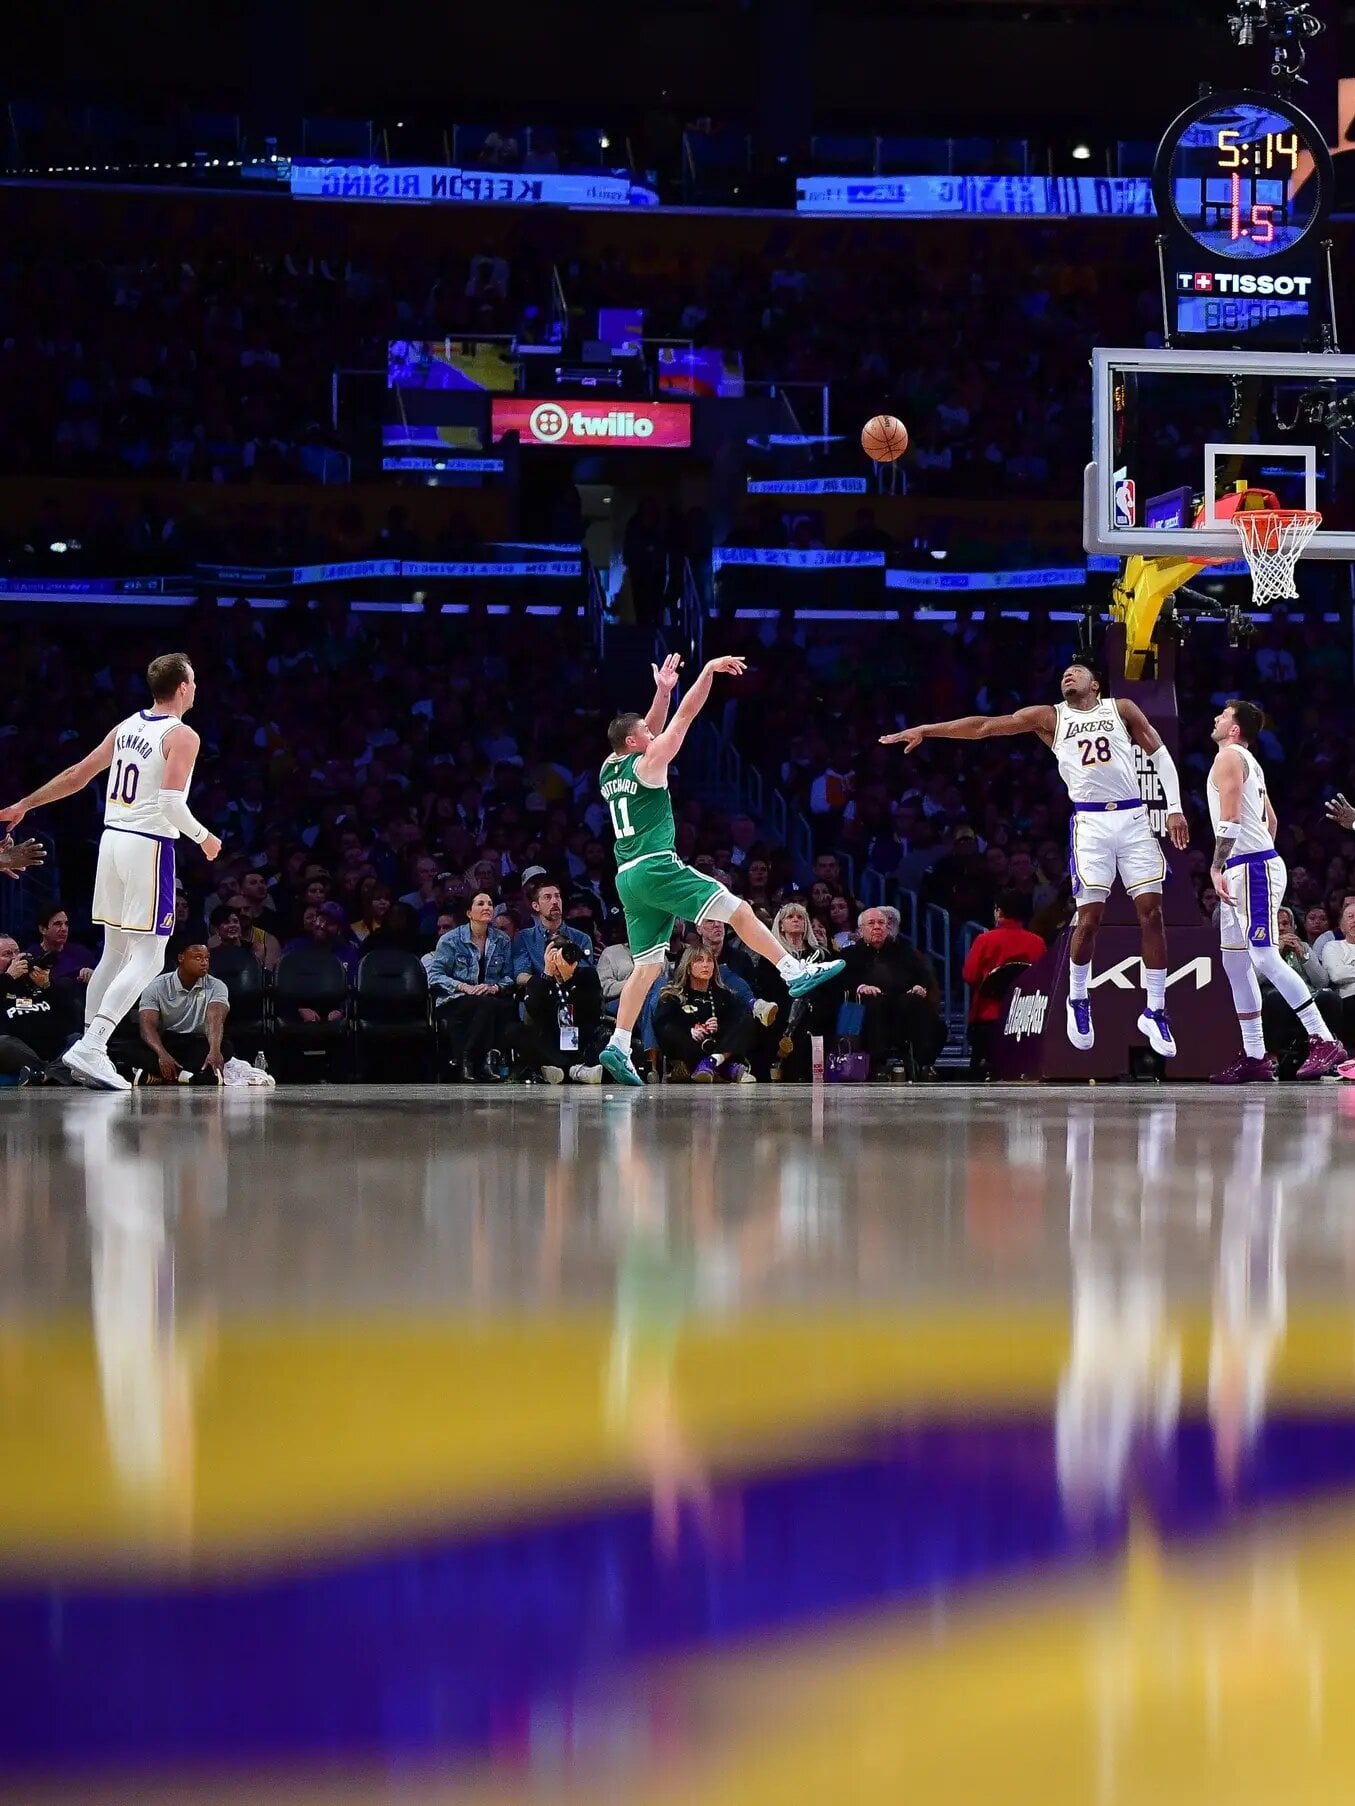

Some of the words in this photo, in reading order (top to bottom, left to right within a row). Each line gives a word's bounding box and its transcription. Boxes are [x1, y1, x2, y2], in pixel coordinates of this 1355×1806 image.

[1218, 131, 1298, 169] 5:14
[1231, 172, 1274, 242] 1.5
[1215, 274, 1312, 295] TISSOT
[570, 411, 654, 438] twilio
[1063, 720, 1115, 740] LAKERS
[117, 734, 153, 760] KENNARD
[1077, 736, 1112, 767] 28
[109, 758, 140, 806] 10
[1137, 773, 1163, 801] HE
[609, 797, 636, 839] 11
